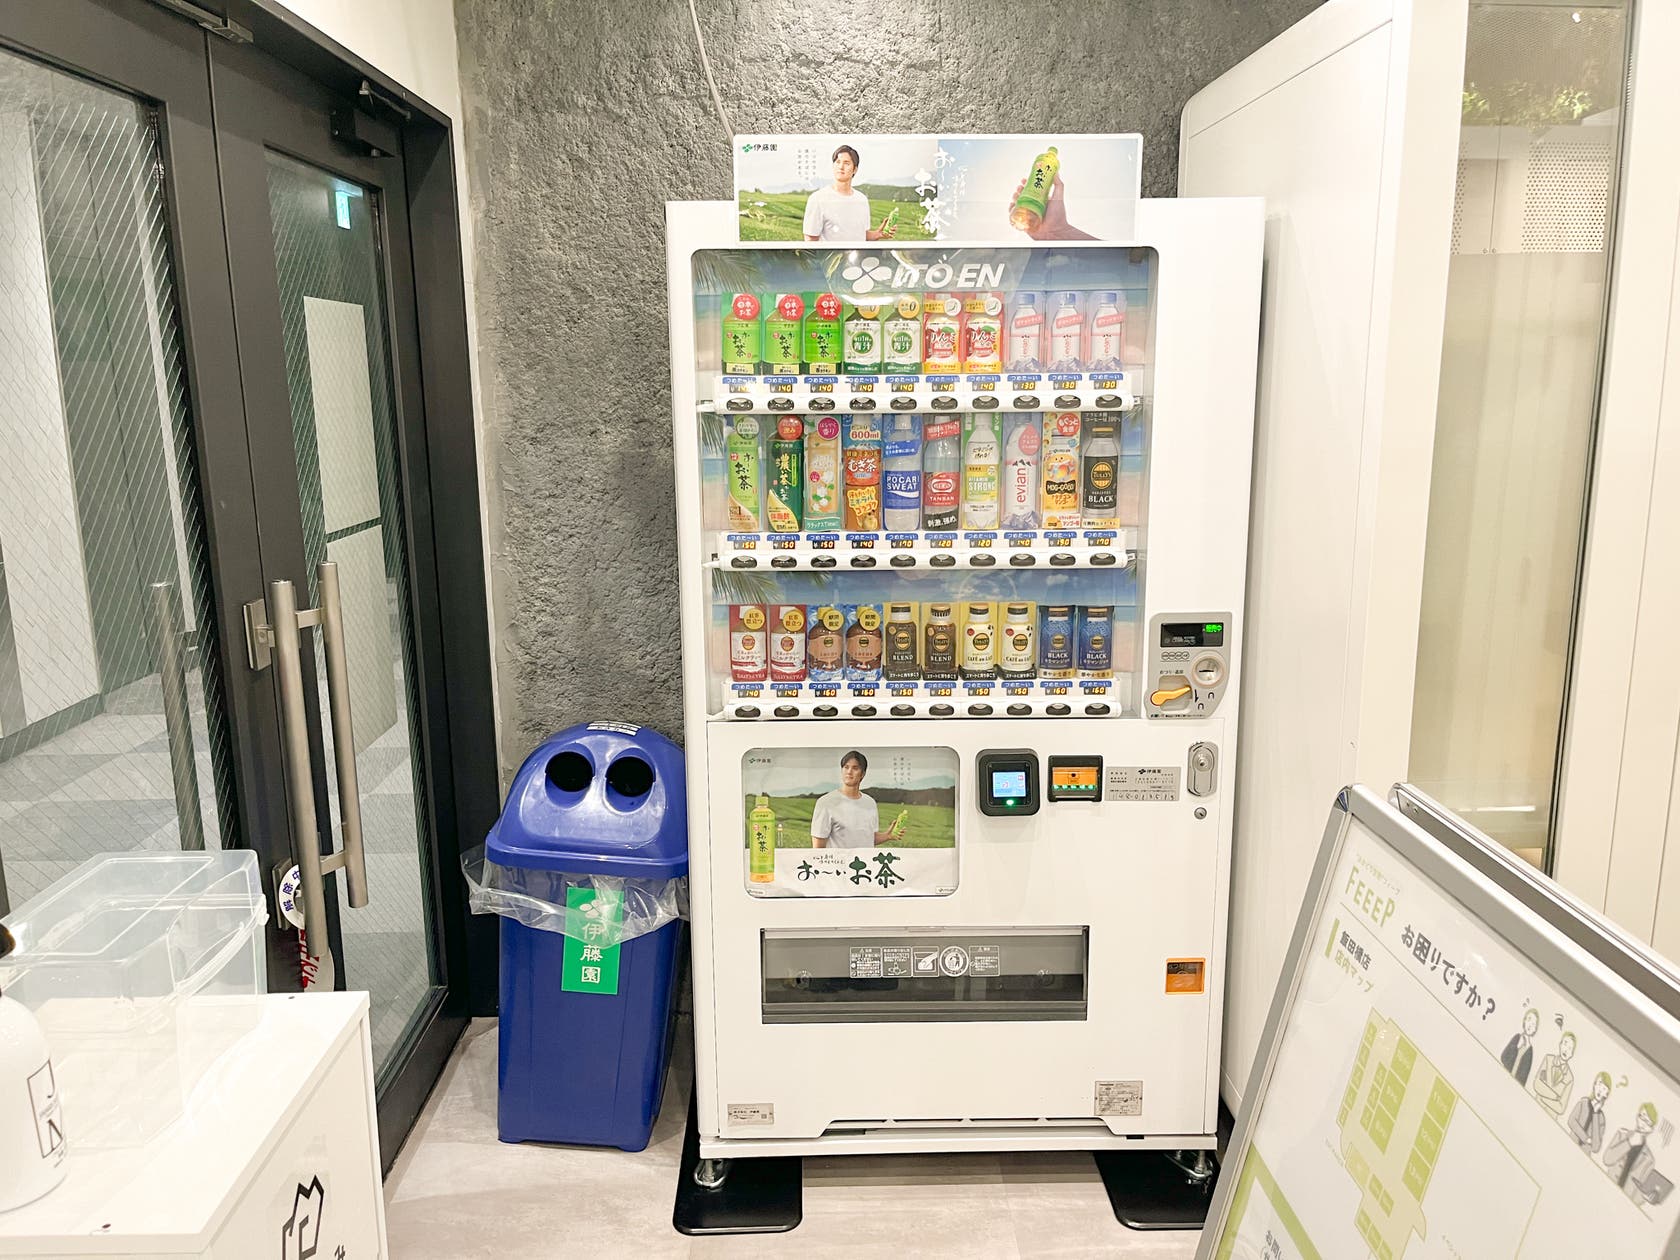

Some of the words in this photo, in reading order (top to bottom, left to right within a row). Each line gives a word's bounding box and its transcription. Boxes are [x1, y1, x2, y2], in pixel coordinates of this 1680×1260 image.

[914, 168, 950, 234] お茶
[956, 264, 1005, 288] EN
[852, 431, 879, 439] 600ml
[848, 458, 876, 472] むぎ茶
[1016, 468, 1027, 503] evian
[1345, 865, 1396, 928] FEEEP
[580, 922, 603, 984] 伊藤園
[1334, 949, 1374, 992] 店内マップ
[1340, 930, 1372, 970] 飯田橋店
[1401, 924, 1496, 1020] お困りですか？
